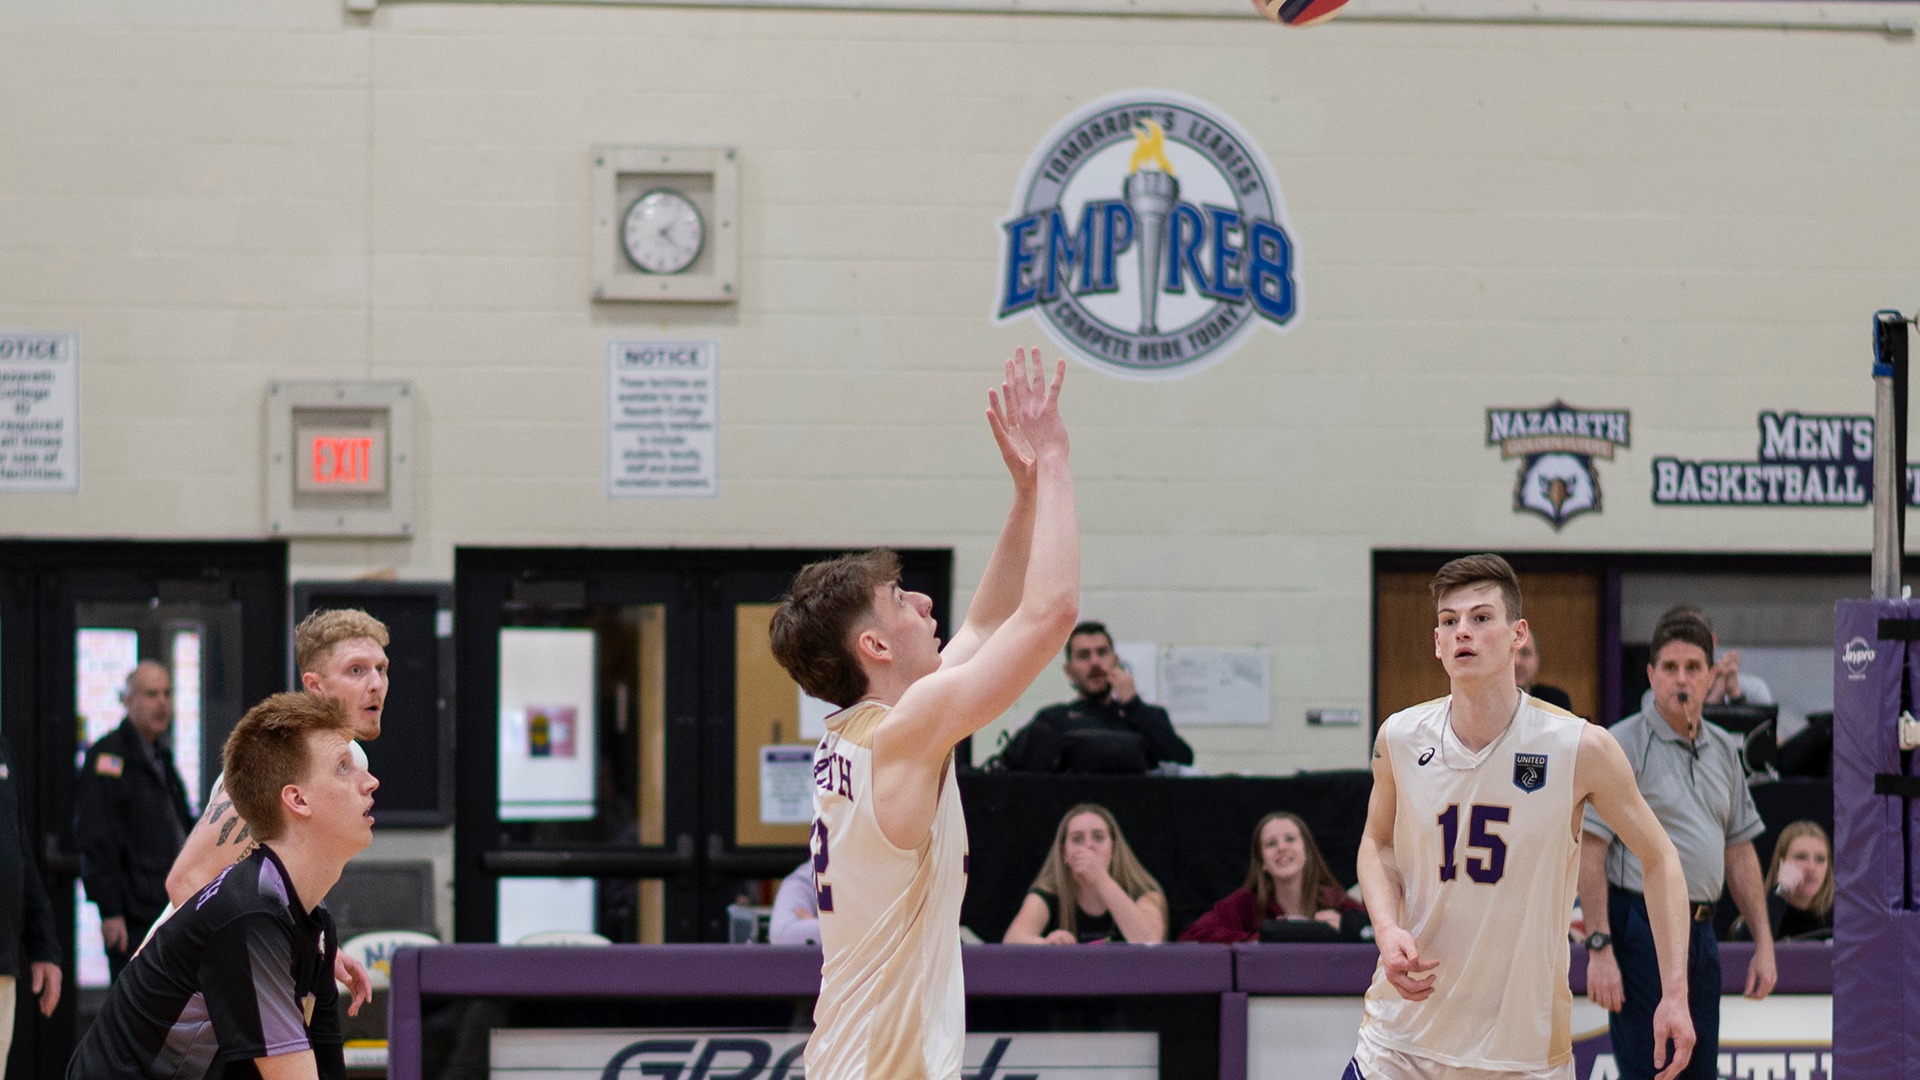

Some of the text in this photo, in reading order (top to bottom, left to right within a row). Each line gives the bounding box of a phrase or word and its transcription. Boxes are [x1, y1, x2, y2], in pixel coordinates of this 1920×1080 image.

[1188, 116, 1257, 196] LEADERS
[0, 339, 57, 360] OTICE
[1054, 301, 1240, 361] COMPETE HERE TODAY
[625, 350, 699, 366] NOTICE
[1490, 411, 1625, 444] NAZARETH
[1762, 415, 1873, 461] MEN'S
[312, 437, 373, 483] EXIT
[1656, 461, 1866, 502] BASKETBALL
[1842, 642, 1876, 665] Jaypro
[1516, 755, 1545, 765] UNITED
[1436, 802, 1512, 887] 15
